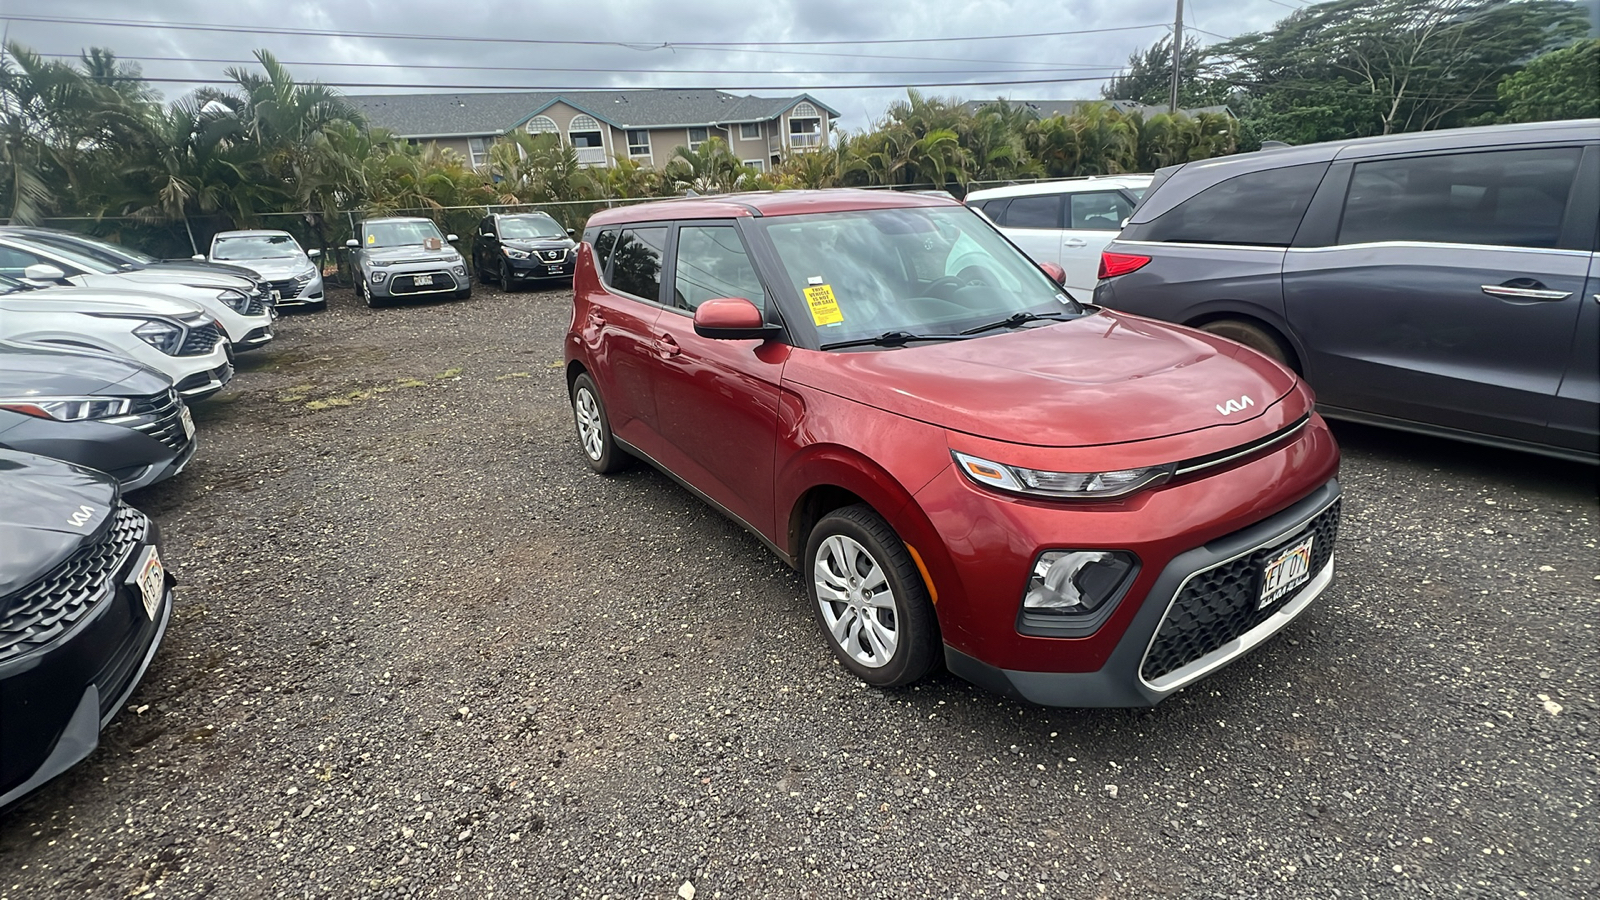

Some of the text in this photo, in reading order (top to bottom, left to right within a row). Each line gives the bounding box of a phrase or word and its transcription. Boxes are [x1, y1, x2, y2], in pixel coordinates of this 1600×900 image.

[809, 290, 830, 298] VEHICLE
[1215, 395, 1254, 416] KIA
[67, 505, 95, 527] KIA
